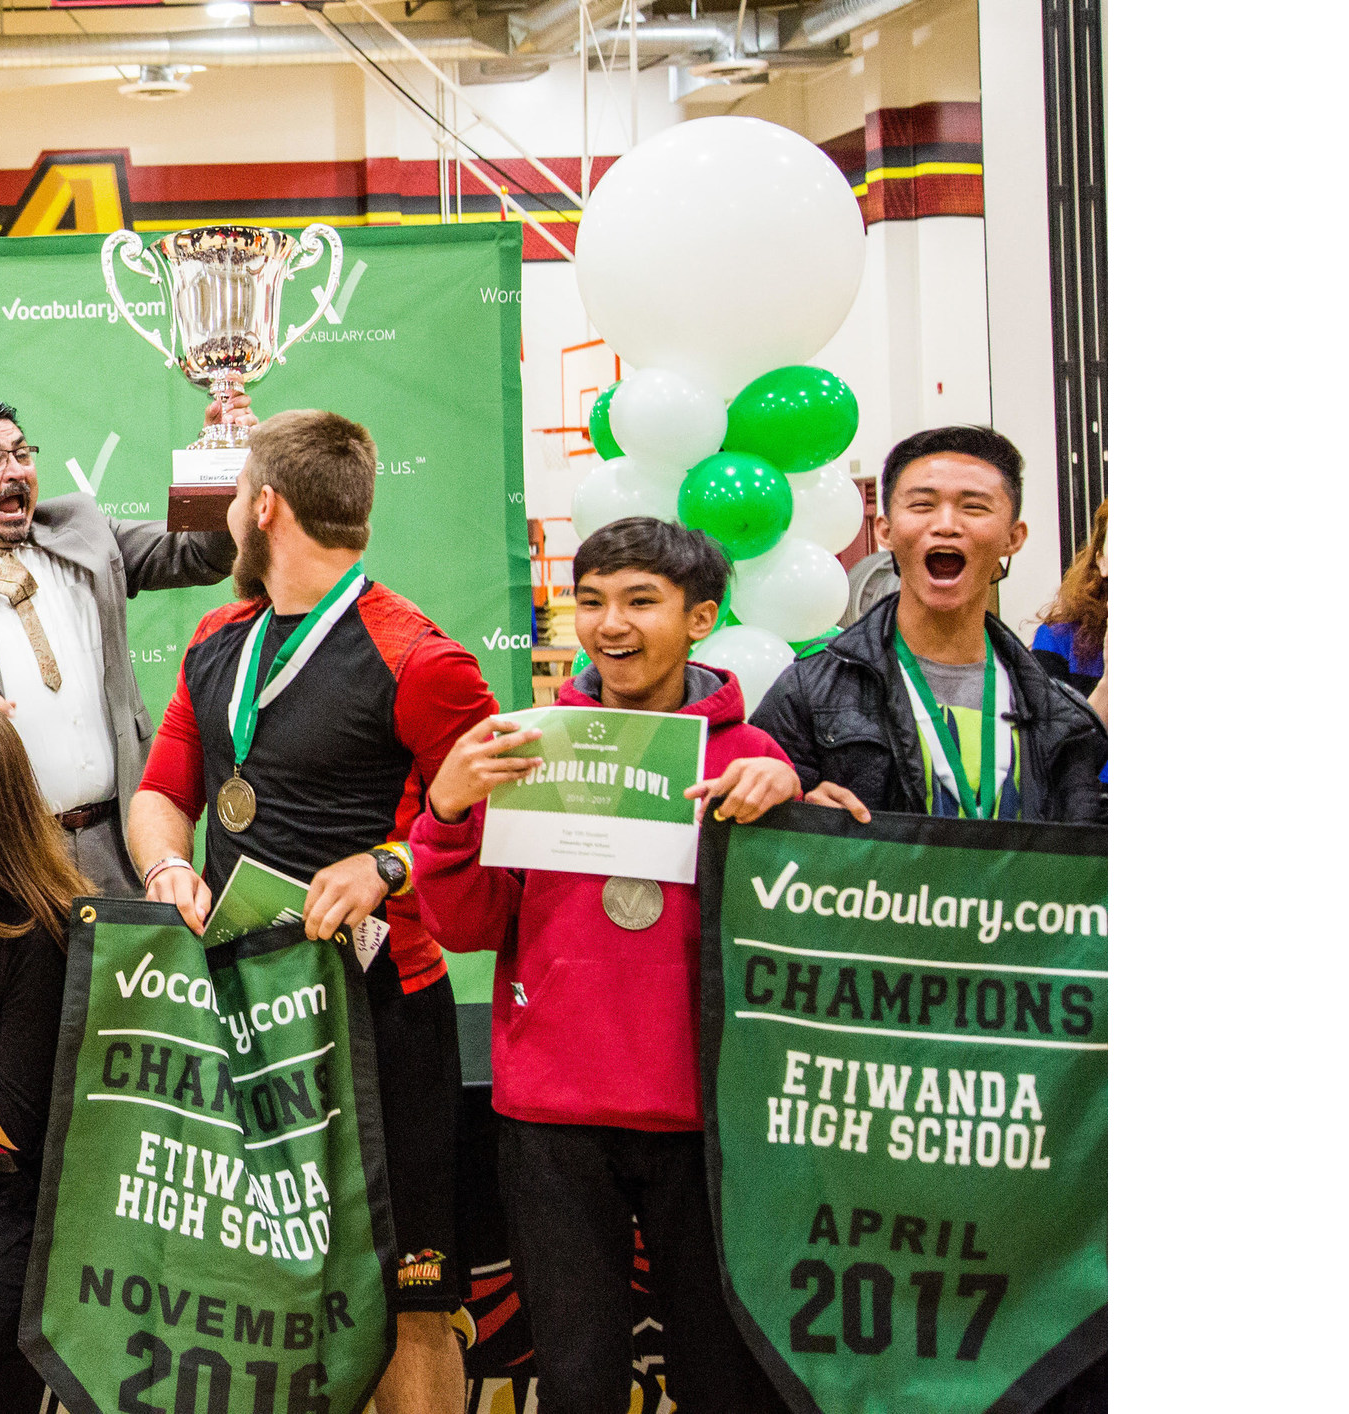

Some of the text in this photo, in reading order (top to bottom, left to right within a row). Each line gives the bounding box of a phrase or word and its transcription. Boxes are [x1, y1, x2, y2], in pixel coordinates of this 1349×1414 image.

[2, 297, 166, 324] Vocabulary.com
[285, 329, 396, 343] CABULARY.COM
[98, 502, 150, 515] ARY.COM
[483, 627, 531, 651] Voca
[624, 765, 670, 801] BOWL
[750, 860, 1108, 944] Vocabulary.com
[744, 955, 1095, 1037] CHAMPIONS
[782, 1049, 1043, 1121] ETIWANDA
[767, 1097, 1051, 1170] HIGH SCHOOL
[115, 1174, 332, 1261] HIGH SCHOO
[808, 1203, 989, 1262] APRIL
[78, 1264, 356, 1351] NOVEMBR
[789, 1258, 1009, 1361] 2017
